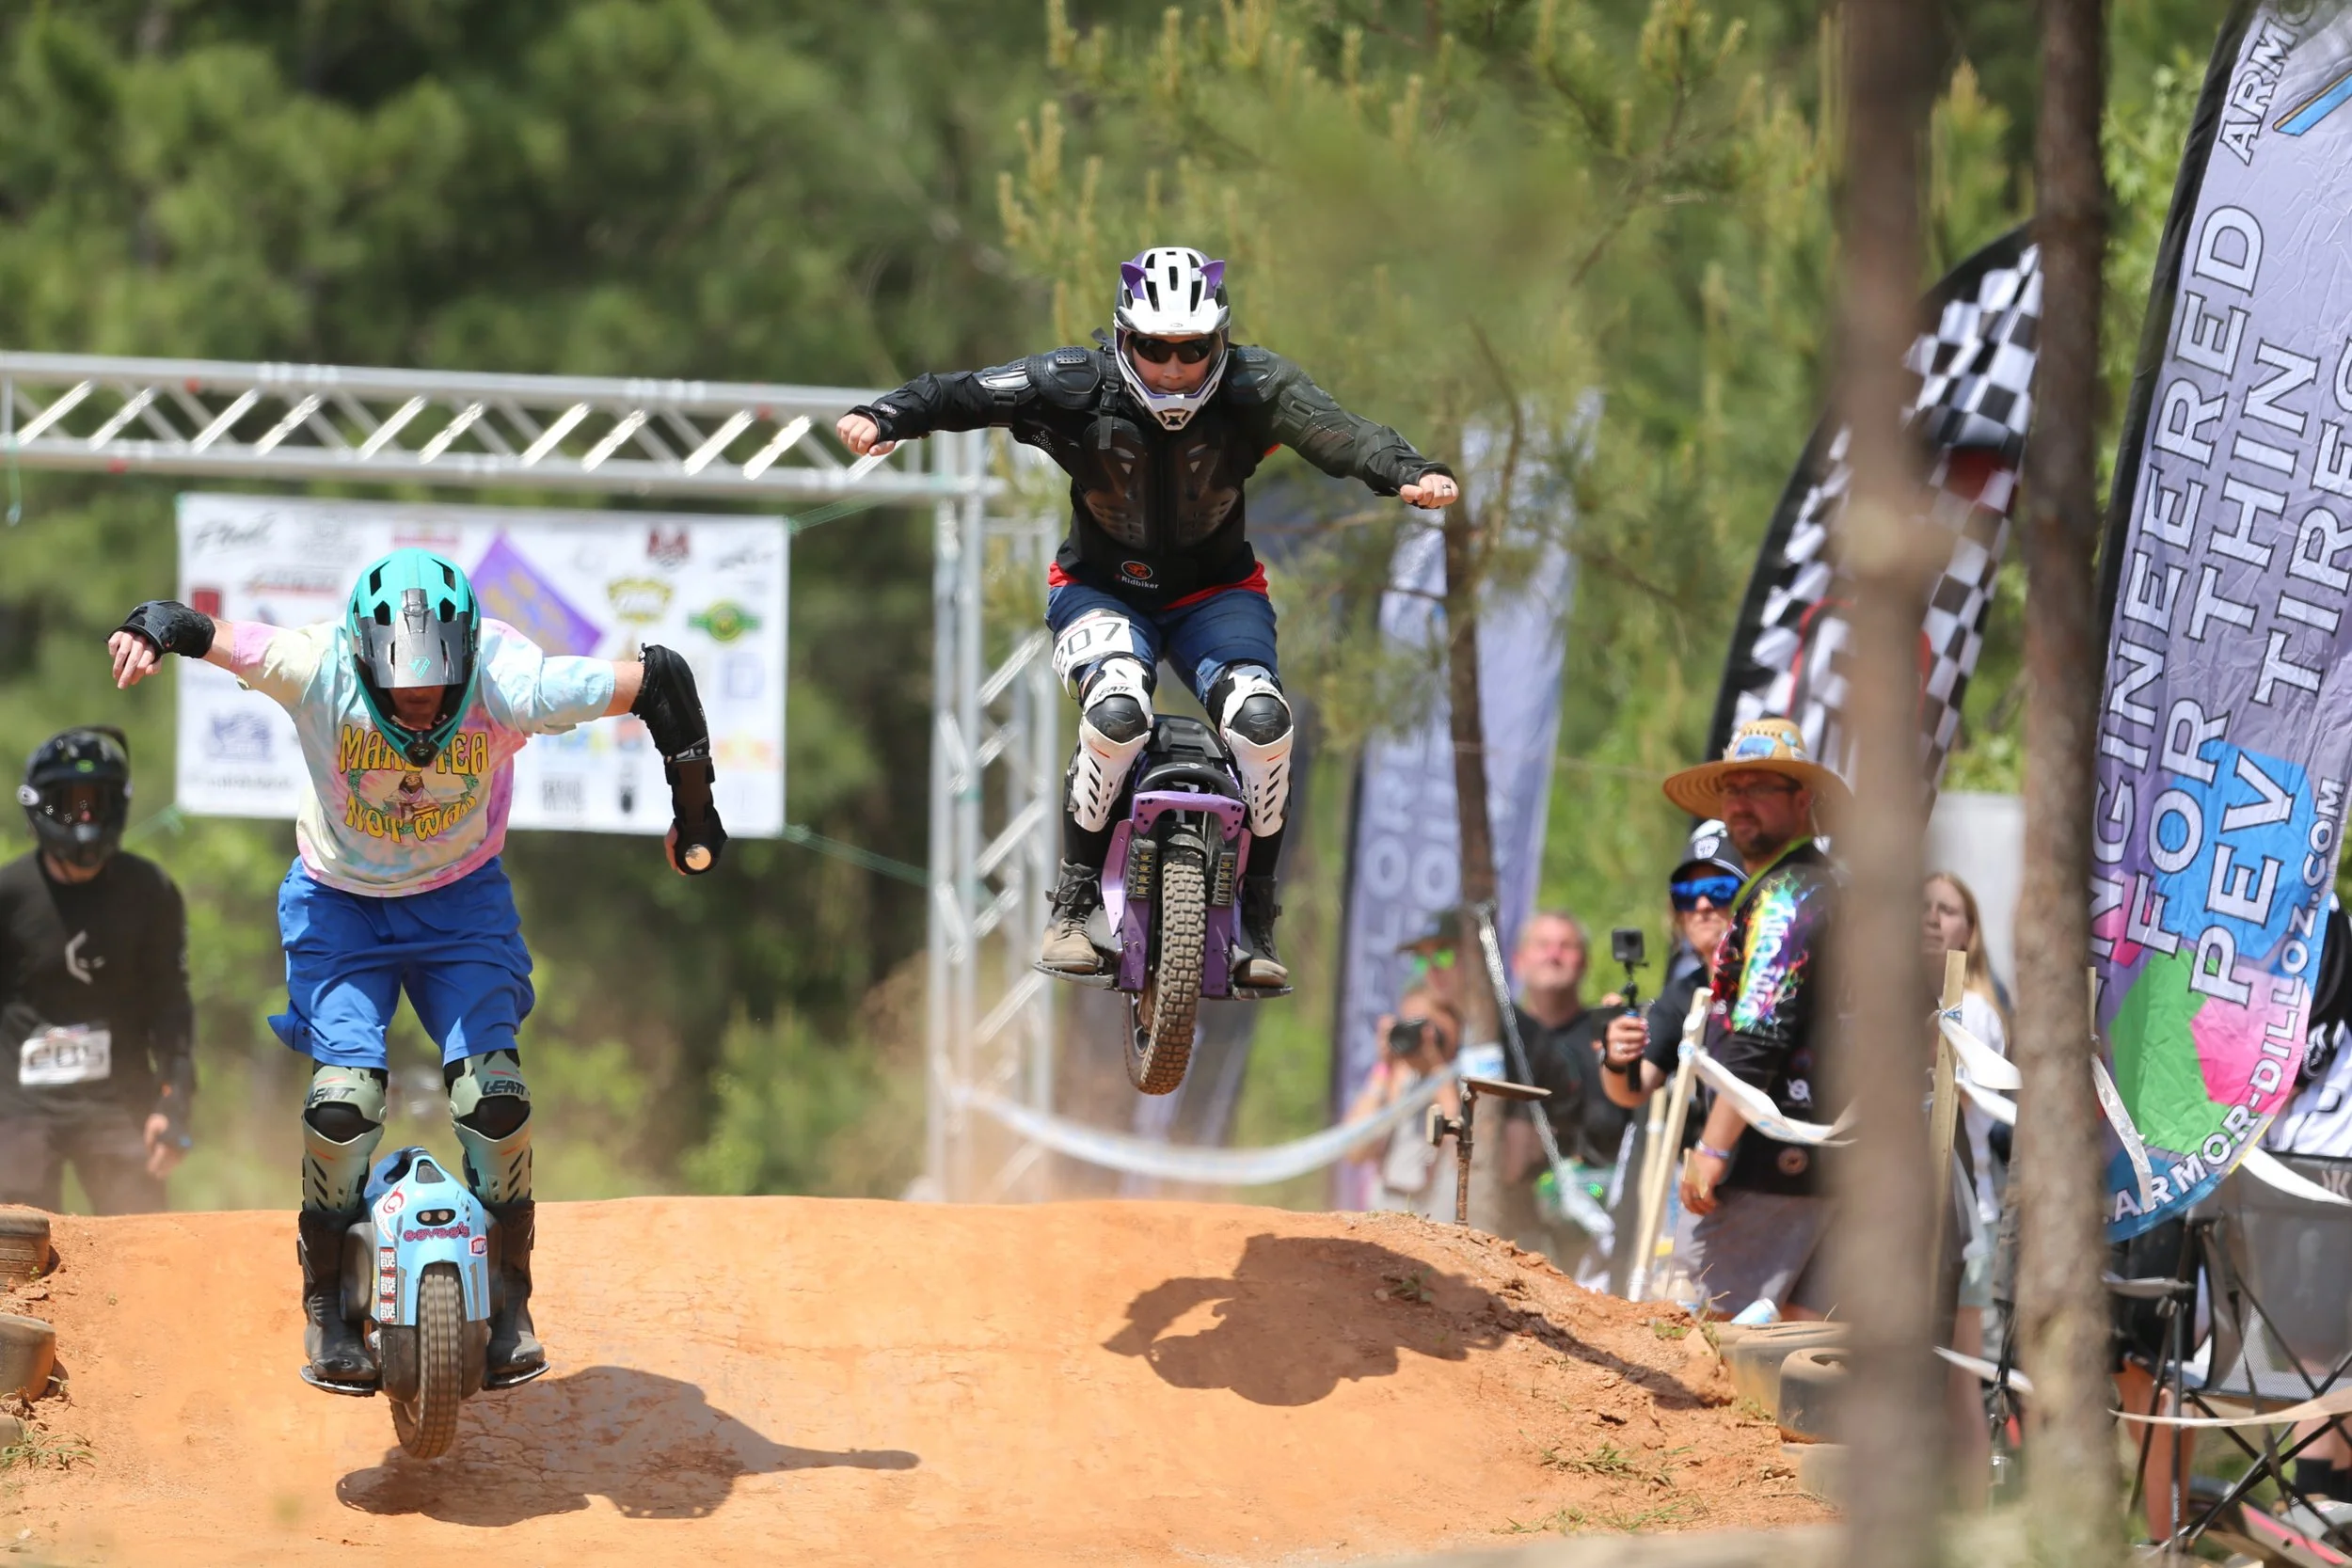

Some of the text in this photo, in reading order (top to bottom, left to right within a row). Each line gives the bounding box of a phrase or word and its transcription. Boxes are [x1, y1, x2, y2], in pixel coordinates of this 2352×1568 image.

[2087, 204, 2265, 1021] NGINEERED
[2124, 337, 2321, 959] FOR THIN
[344, 793, 404, 844] NOT
[2188, 748, 2296, 1009] PEV
[306, 1086, 357, 1110] LEATT
[380, 1251, 396, 1259] RIDE
[380, 1259, 396, 1268] EUC
[380, 1276, 396, 1285] RIDE
[380, 1284, 396, 1294] EUC
[380, 1302, 396, 1310] RIDE
[380, 1309, 396, 1319] EUC
